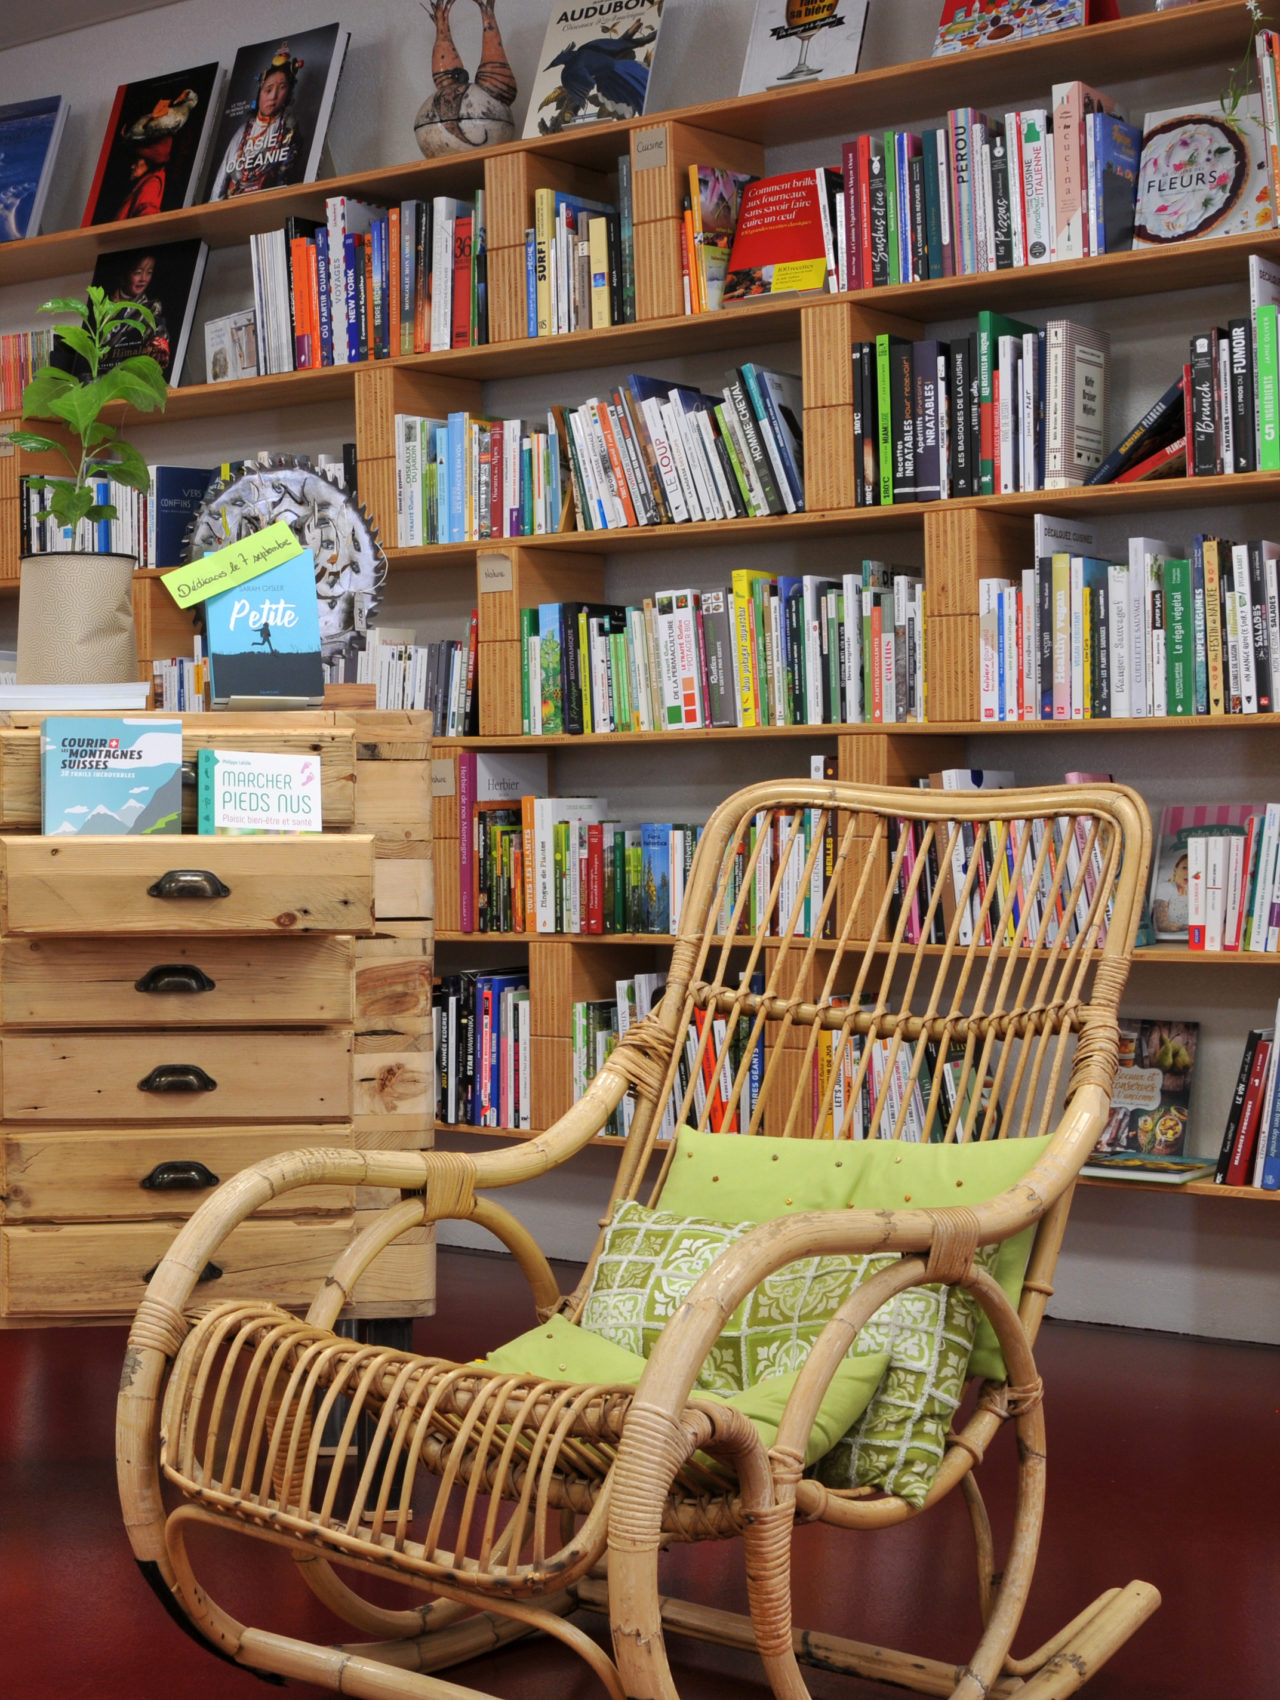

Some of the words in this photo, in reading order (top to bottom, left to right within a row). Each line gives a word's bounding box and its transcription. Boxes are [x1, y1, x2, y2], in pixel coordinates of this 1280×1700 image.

[556, 0, 656, 24] AUDUBON
[790, 9, 802, 18] sa
[804, 2, 834, 16] bière
[244, 133, 278, 152] ASIE
[636, 140, 664, 153] Cuisine
[954, 126, 968, 183] PÉROU
[225, 147, 290, 174] OCÉANIE
[1033, 146, 1043, 196] ITALIENNE
[748, 183, 791, 198] Comment
[1025, 159, 1034, 197] CUISINE
[1147, 170, 1217, 194] FLEURS
[744, 209, 762, 218] sans
[763, 203, 789, 214] savoir
[790, 200, 812, 210] faire
[746, 199, 762, 208] aux
[763, 190, 807, 205] fourneaux
[742, 217, 763, 229] cuire
[995, 197, 1010, 243] Pizzas
[872, 218, 888, 262] Sushis
[537, 251, 546, 282] SURF
[347, 269, 355, 297] YORK
[320, 295, 328, 322] PARTIR
[321, 325, 329, 338] OÙ
[1232, 327, 1246, 374] FUMOIR
[957, 385, 963, 396] LA
[1237, 376, 1243, 385] DU
[730, 381, 750, 421] CHEVAL
[957, 398, 963, 409] DE
[1196, 381, 1214, 433] Brunch
[744, 421, 763, 462] HOMME
[1265, 424, 1274, 440] 5
[655, 438, 673, 476] LOUP
[904, 419, 914, 476] INRATABLES
[667, 478, 679, 494] LE
[177, 571, 228, 599] Dédicaces
[229, 561, 240, 574] le
[241, 553, 249, 566] 7
[252, 539, 292, 565] septembre
[229, 598, 299, 631] Petite
[1055, 590, 1066, 627] vegan
[1171, 592, 1184, 620] végétal
[1195, 589, 1204, 630] LÉGUMES
[1207, 587, 1218, 617] NATURE
[738, 607, 747, 642] superstar
[1172, 622, 1183, 643] régal
[1253, 604, 1261, 647] SALADES
[667, 620, 678, 678] PERMACULTURE
[1043, 632, 1051, 657] vegan
[1173, 645, 1183, 654] Le
[1196, 632, 1204, 662] SUPER
[1209, 626, 1219, 652] FESTIN
[740, 645, 750, 674] potager
[765, 633, 773, 678] TERRARIUMS
[884, 641, 893, 681] cactus
[1055, 630, 1066, 684] Healthy
[673, 678, 679, 690] LA
[673, 691, 679, 700] DE
[741, 676, 750, 692] Mon
[61, 737, 108, 749] COURIR
[68, 748, 143, 760] MONTAGNES
[60, 759, 109, 770] SUISSES
[222, 770, 293, 790] MARCHER
[487, 779, 520, 791] Herbier
[222, 791, 271, 813] PIEDS
[278, 793, 312, 814] NUS
[247, 814, 281, 826] bien-être
[282, 817, 290, 825] et
[292, 816, 313, 827] santé
[825, 837, 833, 877] ABEILLES
[525, 883, 533, 913] TOUTES
